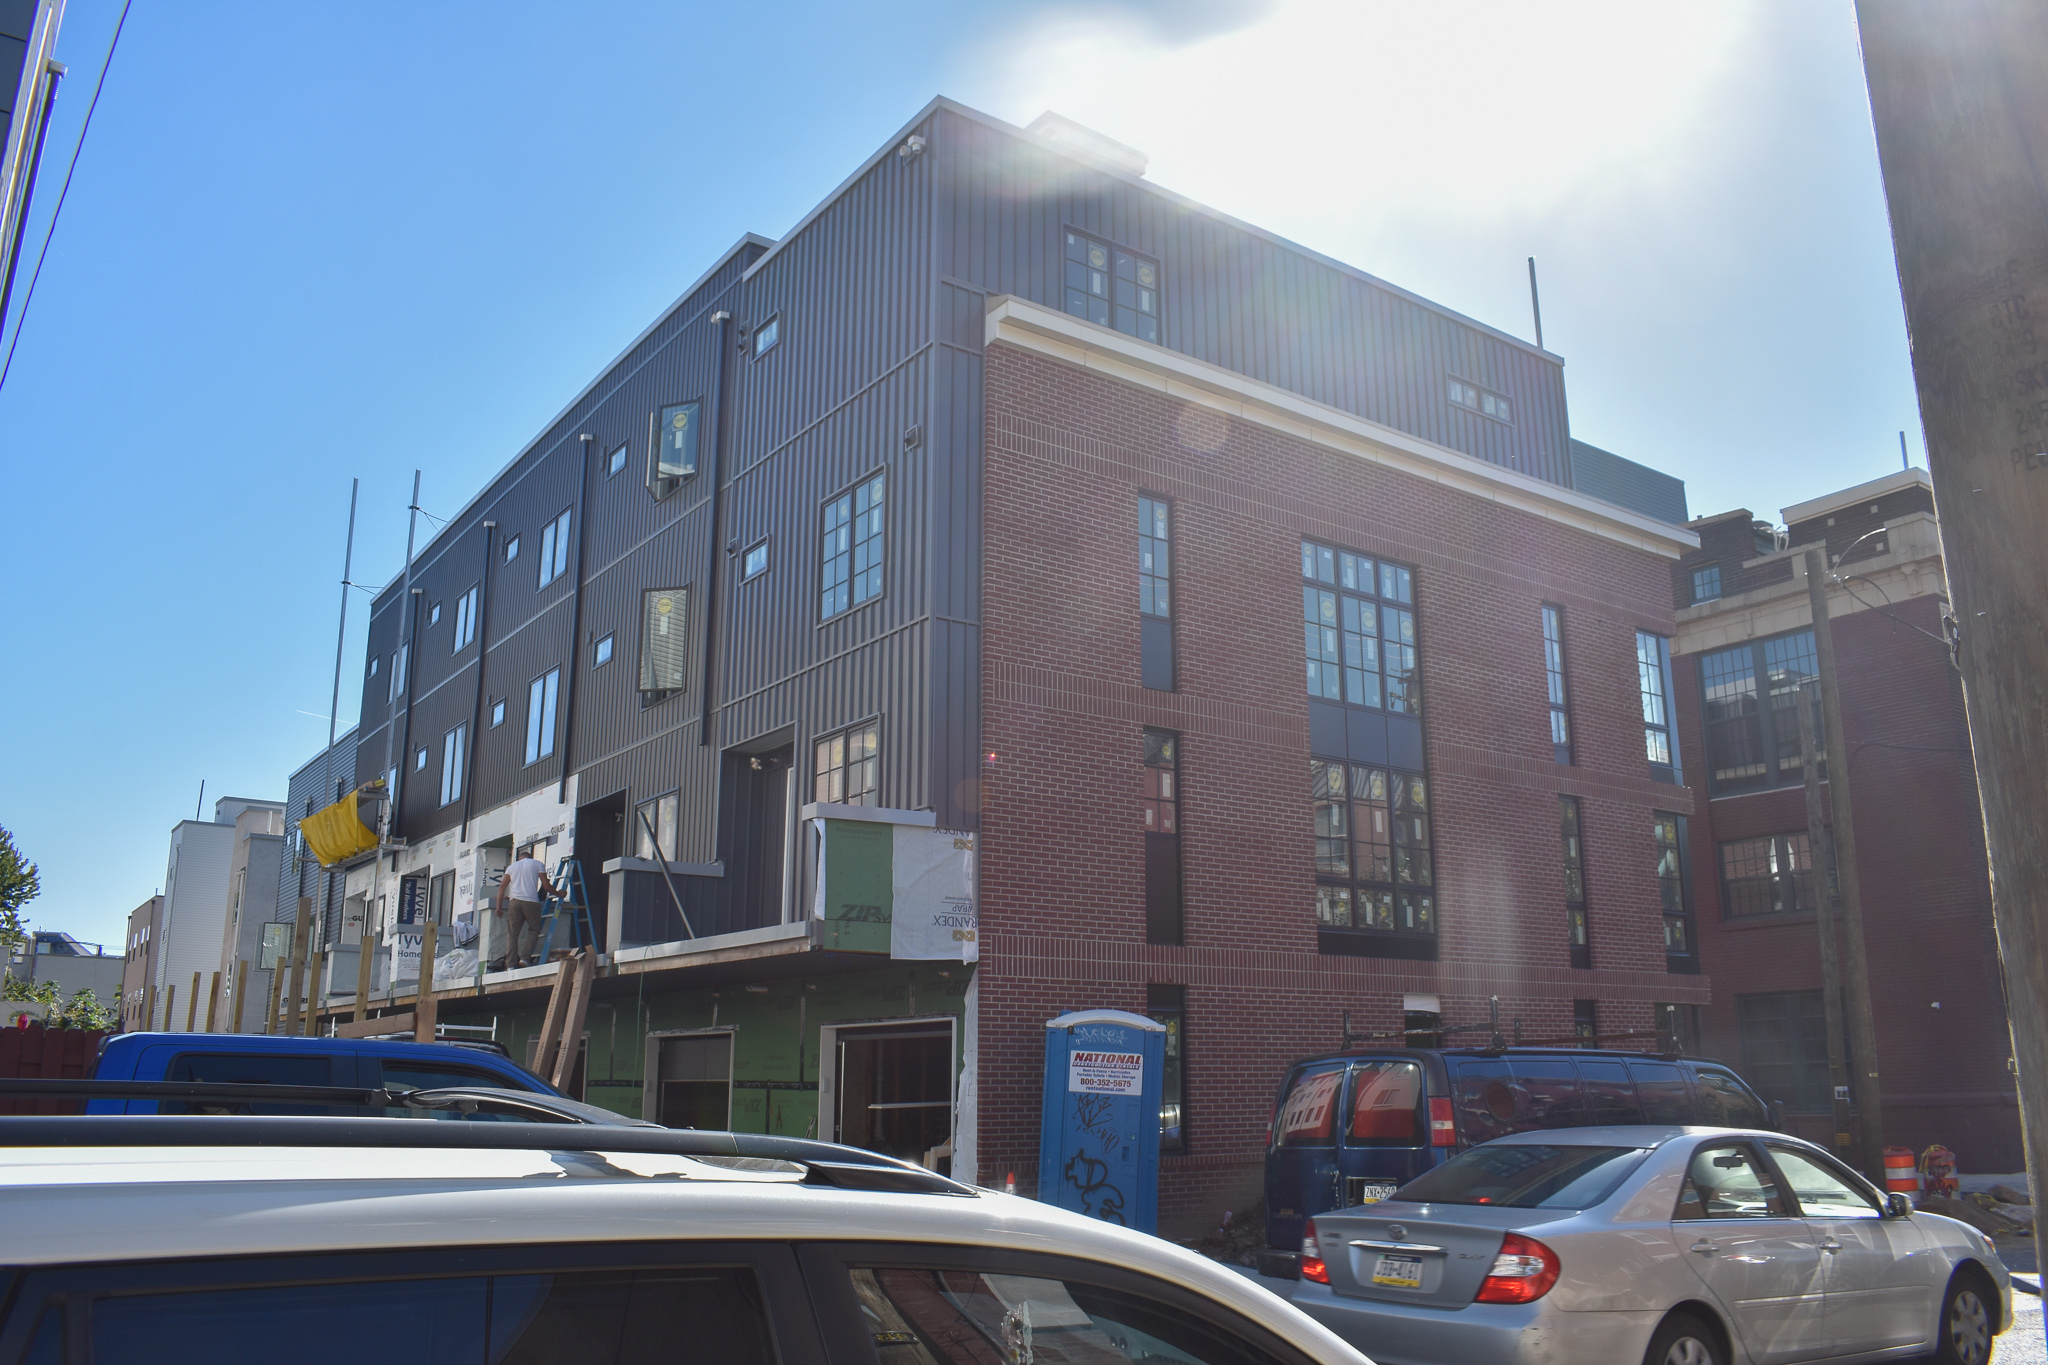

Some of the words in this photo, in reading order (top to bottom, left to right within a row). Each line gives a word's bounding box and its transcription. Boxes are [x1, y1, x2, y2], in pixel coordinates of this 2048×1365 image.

[837, 903, 882, 921] ZIP
[934, 914, 980, 929] RANDEX
[1074, 1052, 1142, 1065] NATIONAL
[1080, 1078, 1131, 1088] 800-352-5675
